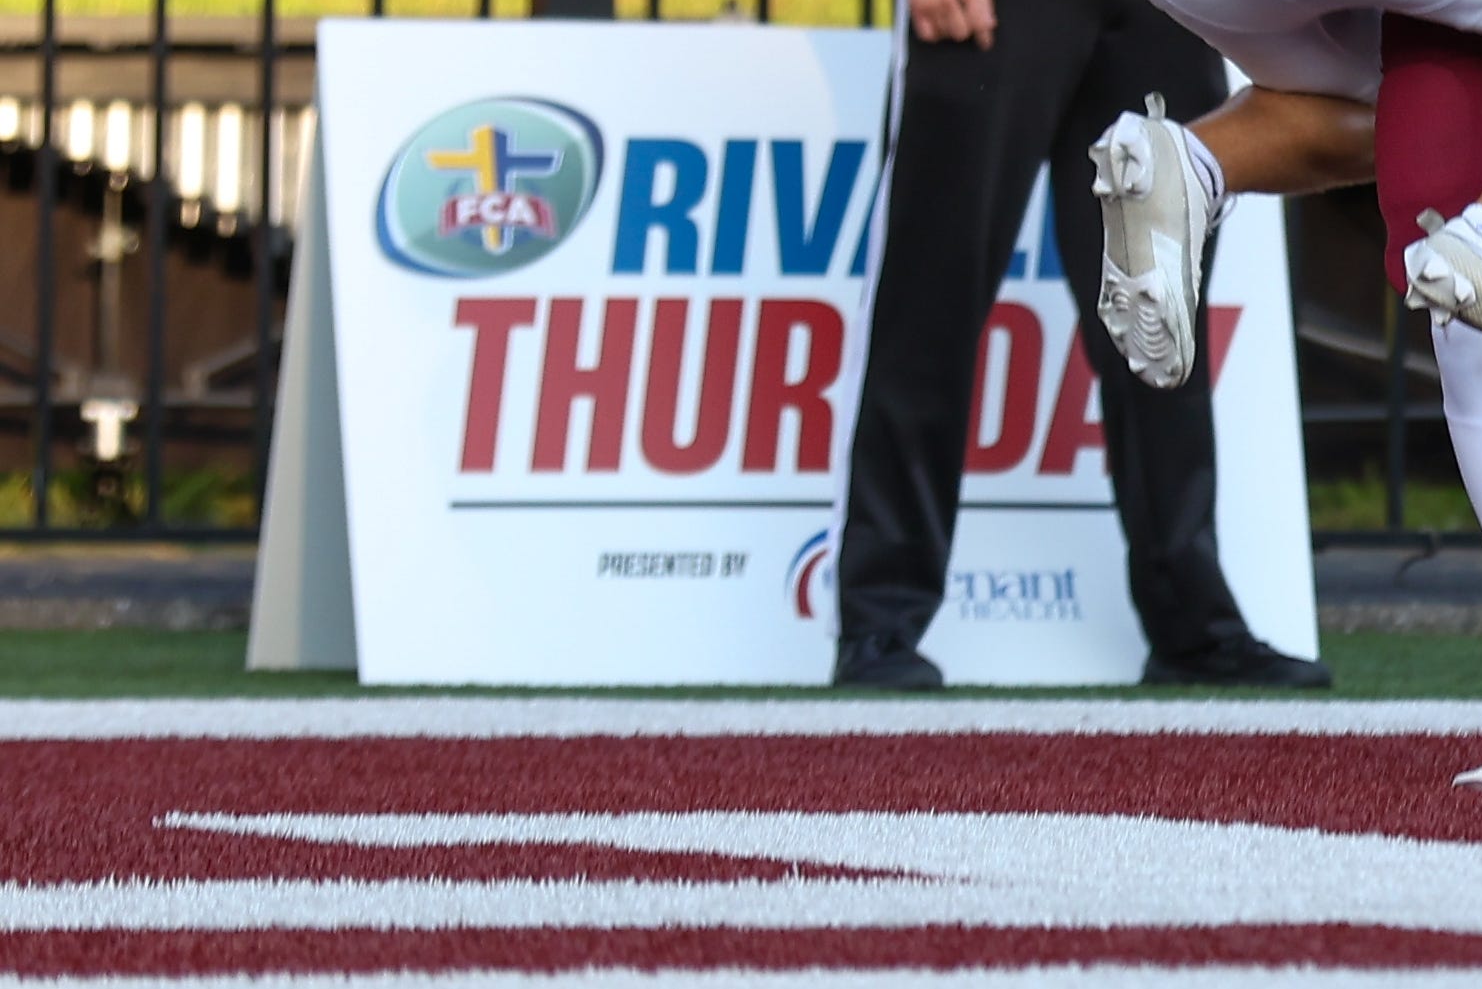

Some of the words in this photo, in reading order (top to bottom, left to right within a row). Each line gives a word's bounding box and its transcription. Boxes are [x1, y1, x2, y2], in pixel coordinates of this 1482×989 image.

[455, 195, 538, 226] FCA
[598, 553, 714, 579] PRESENTED
[721, 553, 750, 578] BY
